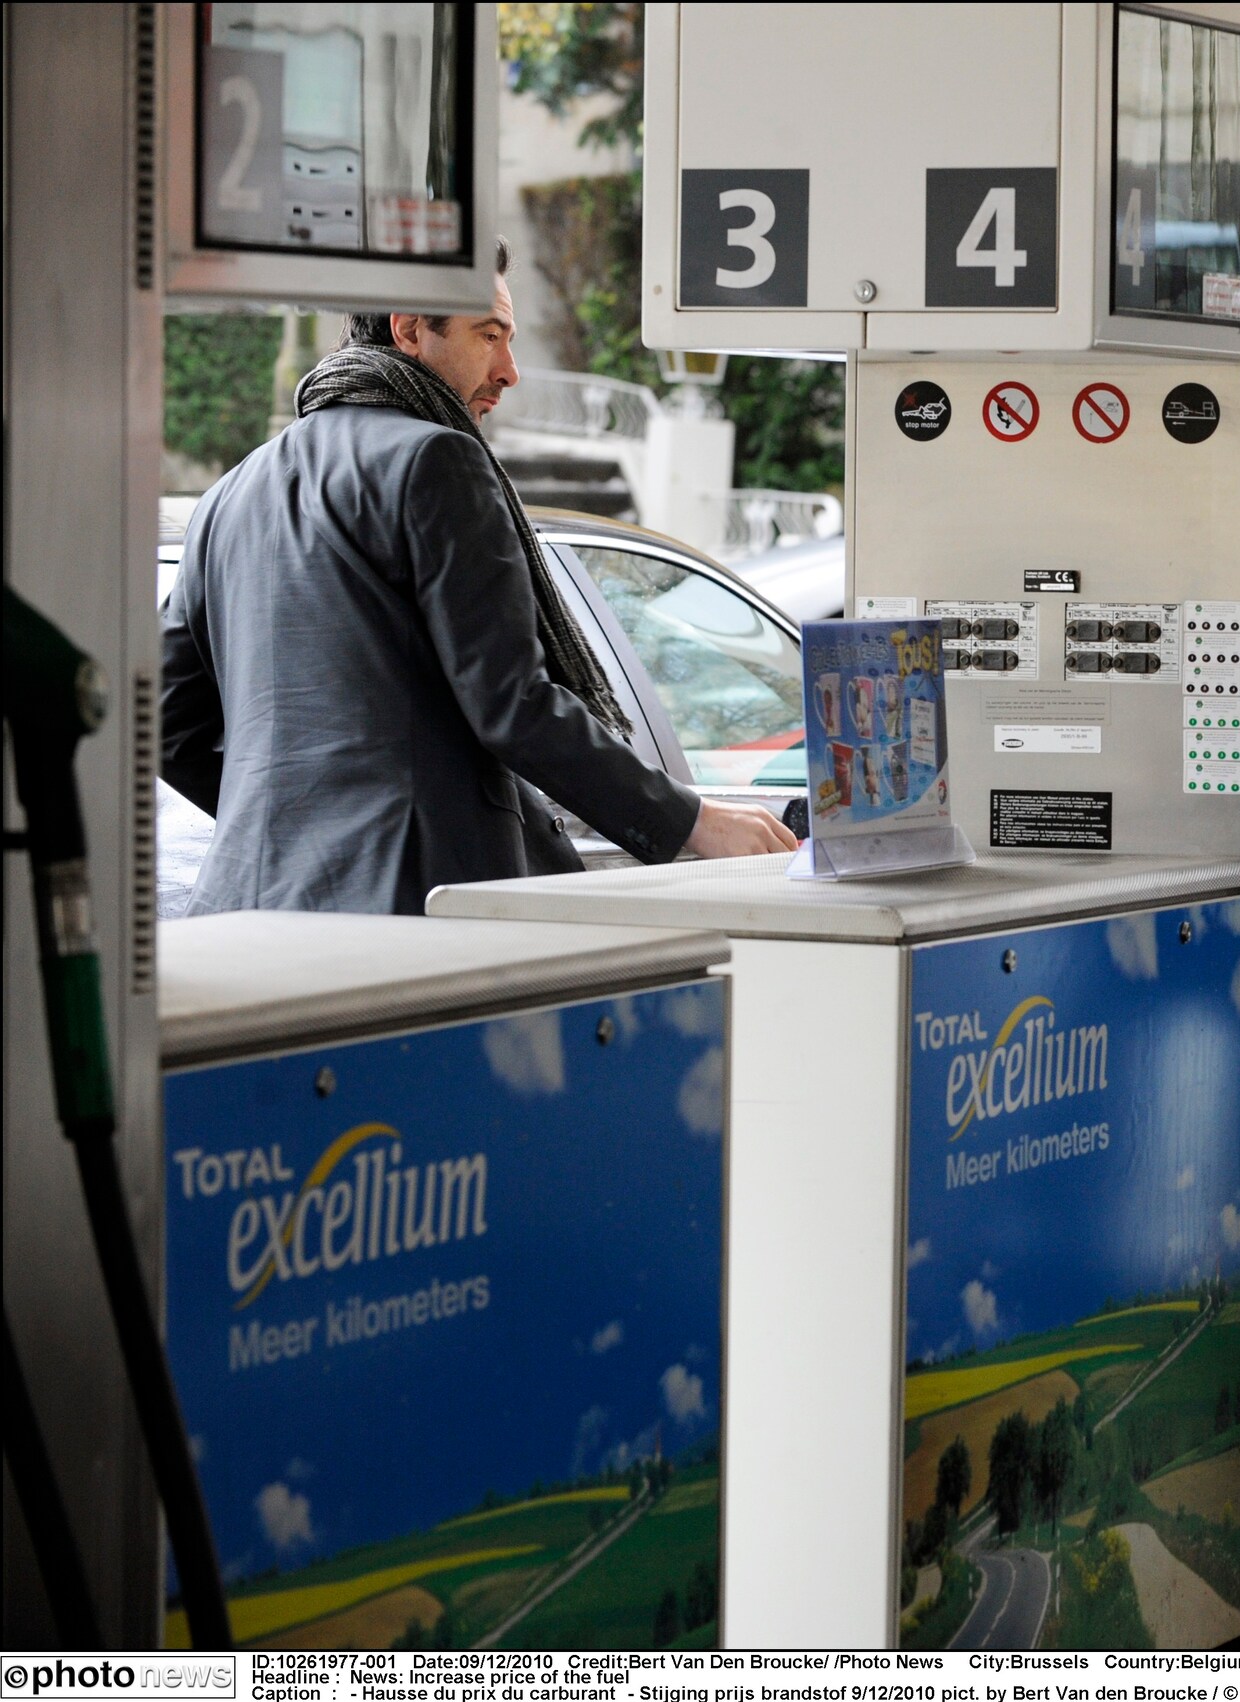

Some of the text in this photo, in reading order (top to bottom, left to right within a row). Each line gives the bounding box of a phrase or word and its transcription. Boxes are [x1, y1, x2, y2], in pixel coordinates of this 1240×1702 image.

[217, 74, 262, 210] 2
[715, 188, 776, 289] 3
[955, 187, 1028, 287] 4
[1118, 187, 1145, 287] 4
[905, 421, 924, 429] stop
[915, 1009, 988, 1051] TOTAL
[946, 1011, 1108, 1127] excellium
[173, 1144, 294, 1200] TOTAL
[946, 1122, 1110, 1191] Meer kilometers
[227, 1142, 488, 1292] excellium
[229, 1274, 490, 1372] Meer kilometers
